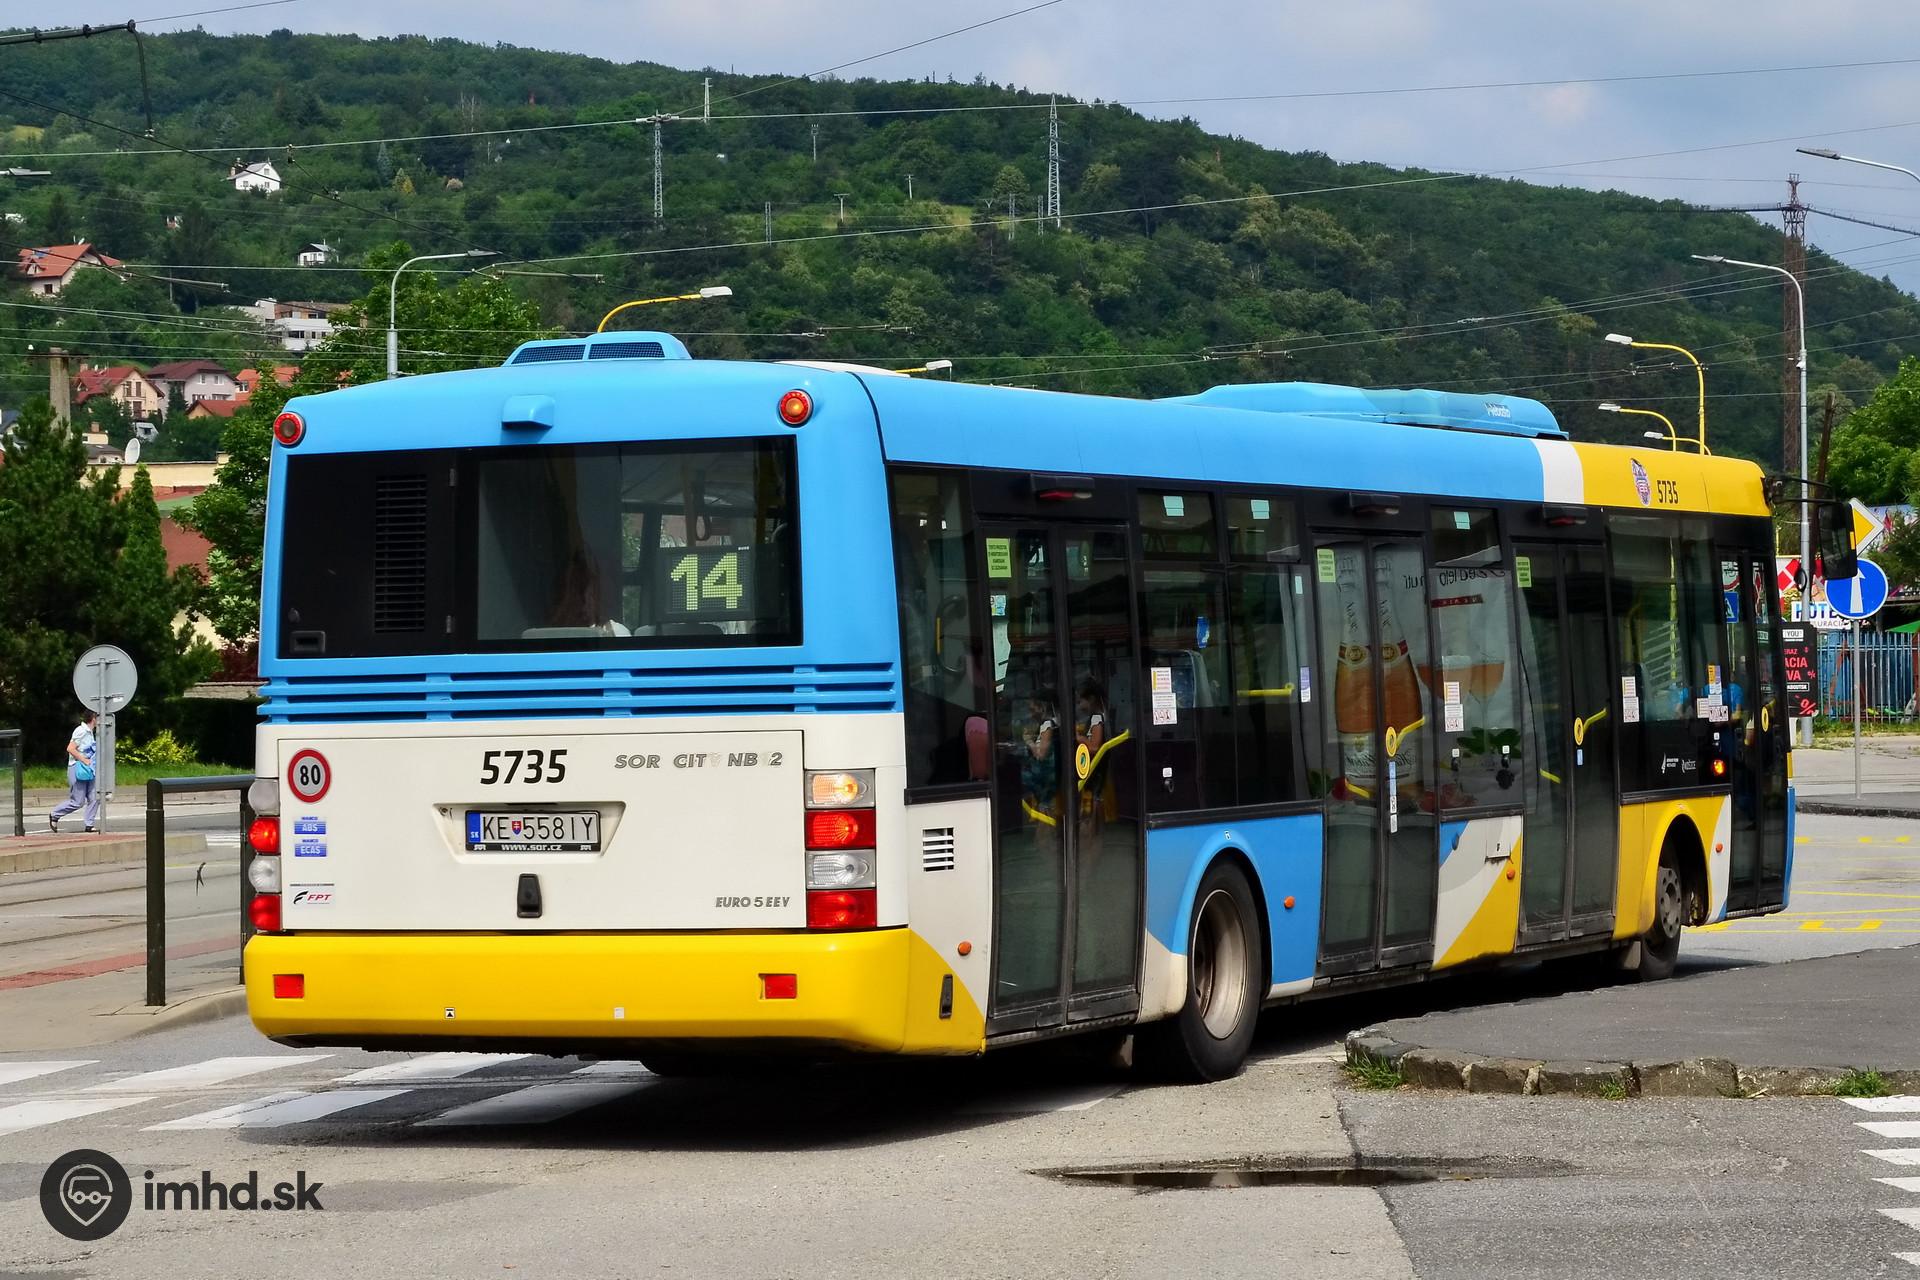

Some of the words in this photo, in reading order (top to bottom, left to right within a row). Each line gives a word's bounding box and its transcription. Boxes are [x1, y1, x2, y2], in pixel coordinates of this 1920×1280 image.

[1656, 480, 1679, 504] 5735
[670, 552, 743, 611] 14
[480, 748, 568, 785] 5735
[614, 754, 661, 769] SOR
[673, 753, 720, 768] CIT
[728, 752, 758, 767] NB
[299, 764, 321, 786] 80
[302, 823, 318, 832] ABS
[300, 846, 321, 855] ECAS
[501, 843, 563, 851] www.sor.cz
[715, 896, 752, 908] EURO
